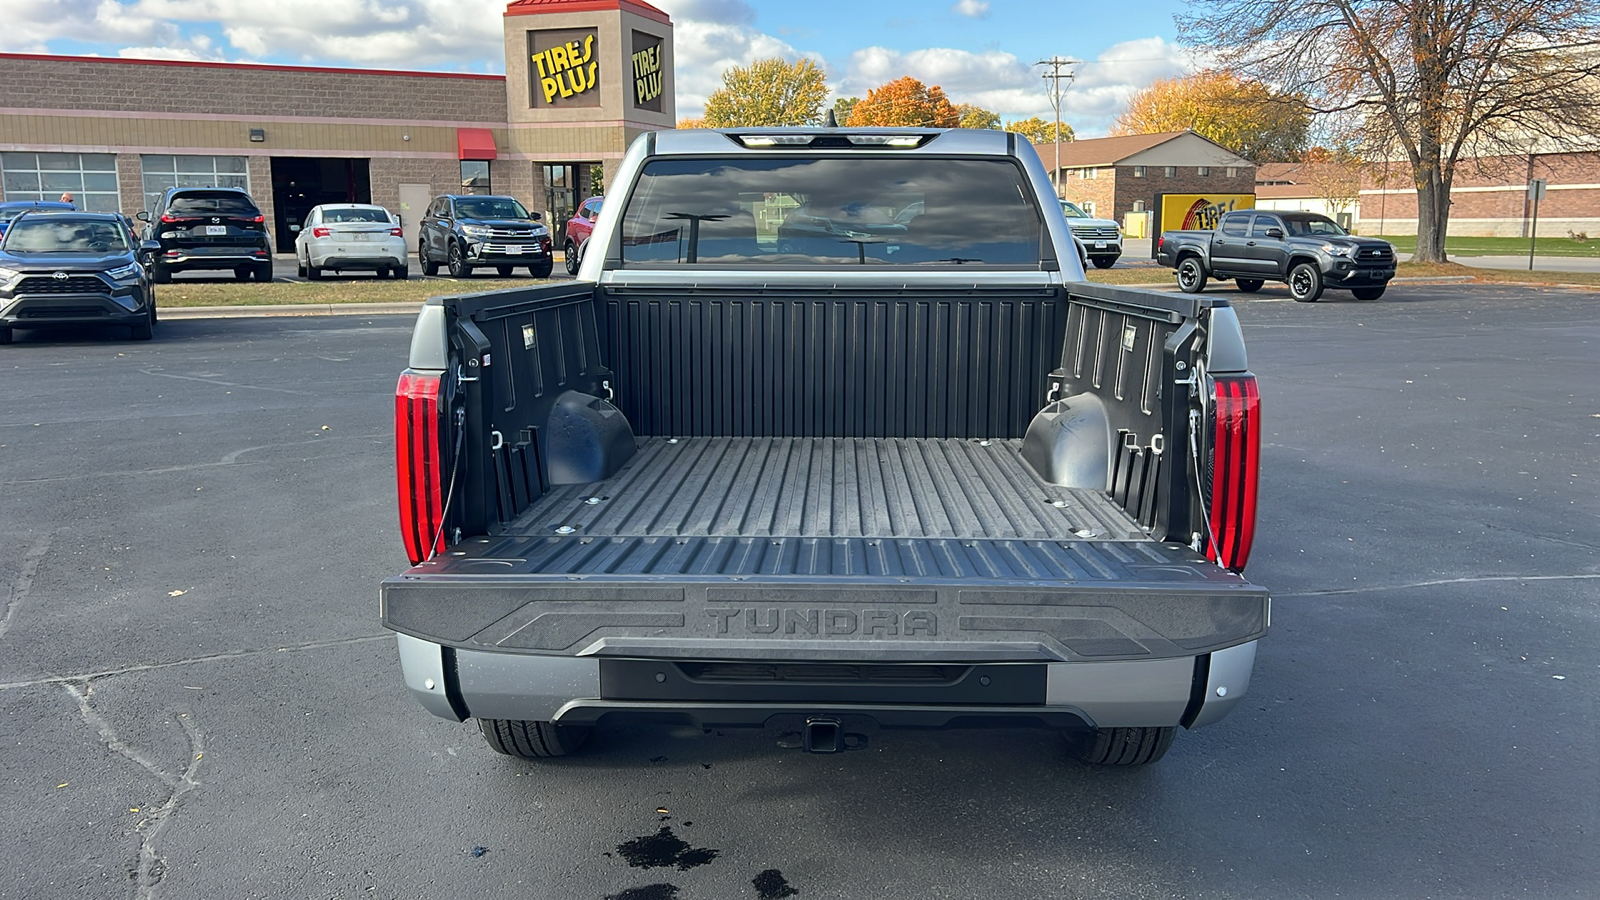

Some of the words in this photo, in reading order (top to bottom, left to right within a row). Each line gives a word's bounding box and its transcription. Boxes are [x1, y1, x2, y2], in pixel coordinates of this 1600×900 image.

[532, 34, 594, 78] TIRES
[632, 44, 661, 79] TIRES
[541, 61, 598, 104] PLUS
[636, 70, 663, 105] PLUS
[704, 607, 937, 636] TUNDRA
